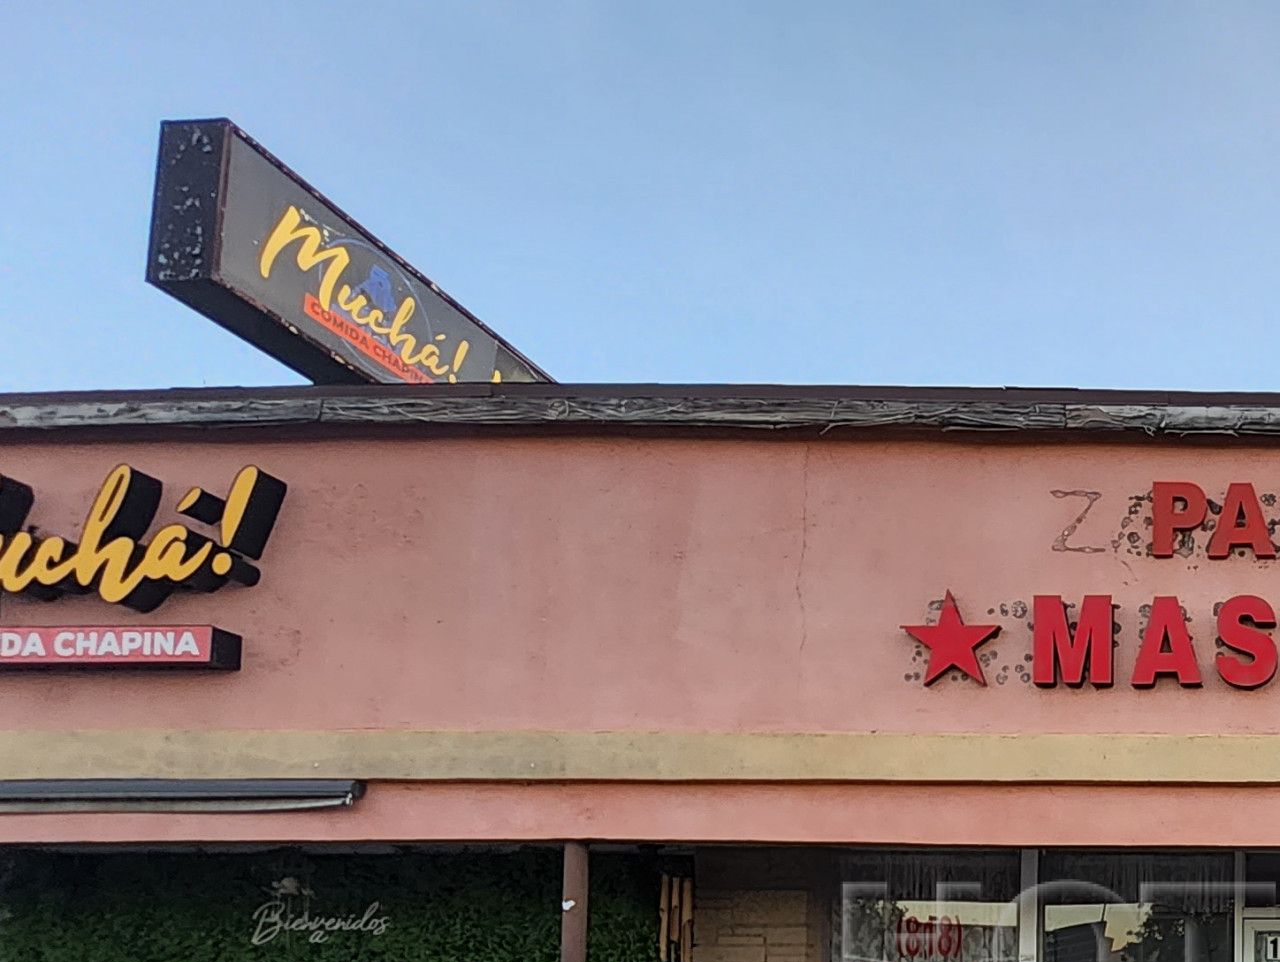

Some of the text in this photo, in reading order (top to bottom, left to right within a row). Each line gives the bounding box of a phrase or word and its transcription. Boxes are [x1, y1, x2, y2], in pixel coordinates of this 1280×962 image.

[310, 301, 369, 347] COMIDA
[0, 463, 260, 604] uchá!
[0, 631, 200, 657] DA CHAPINA
[251, 901, 391, 945] Bienvenidos
[896, 914, 963, 958] (818)
